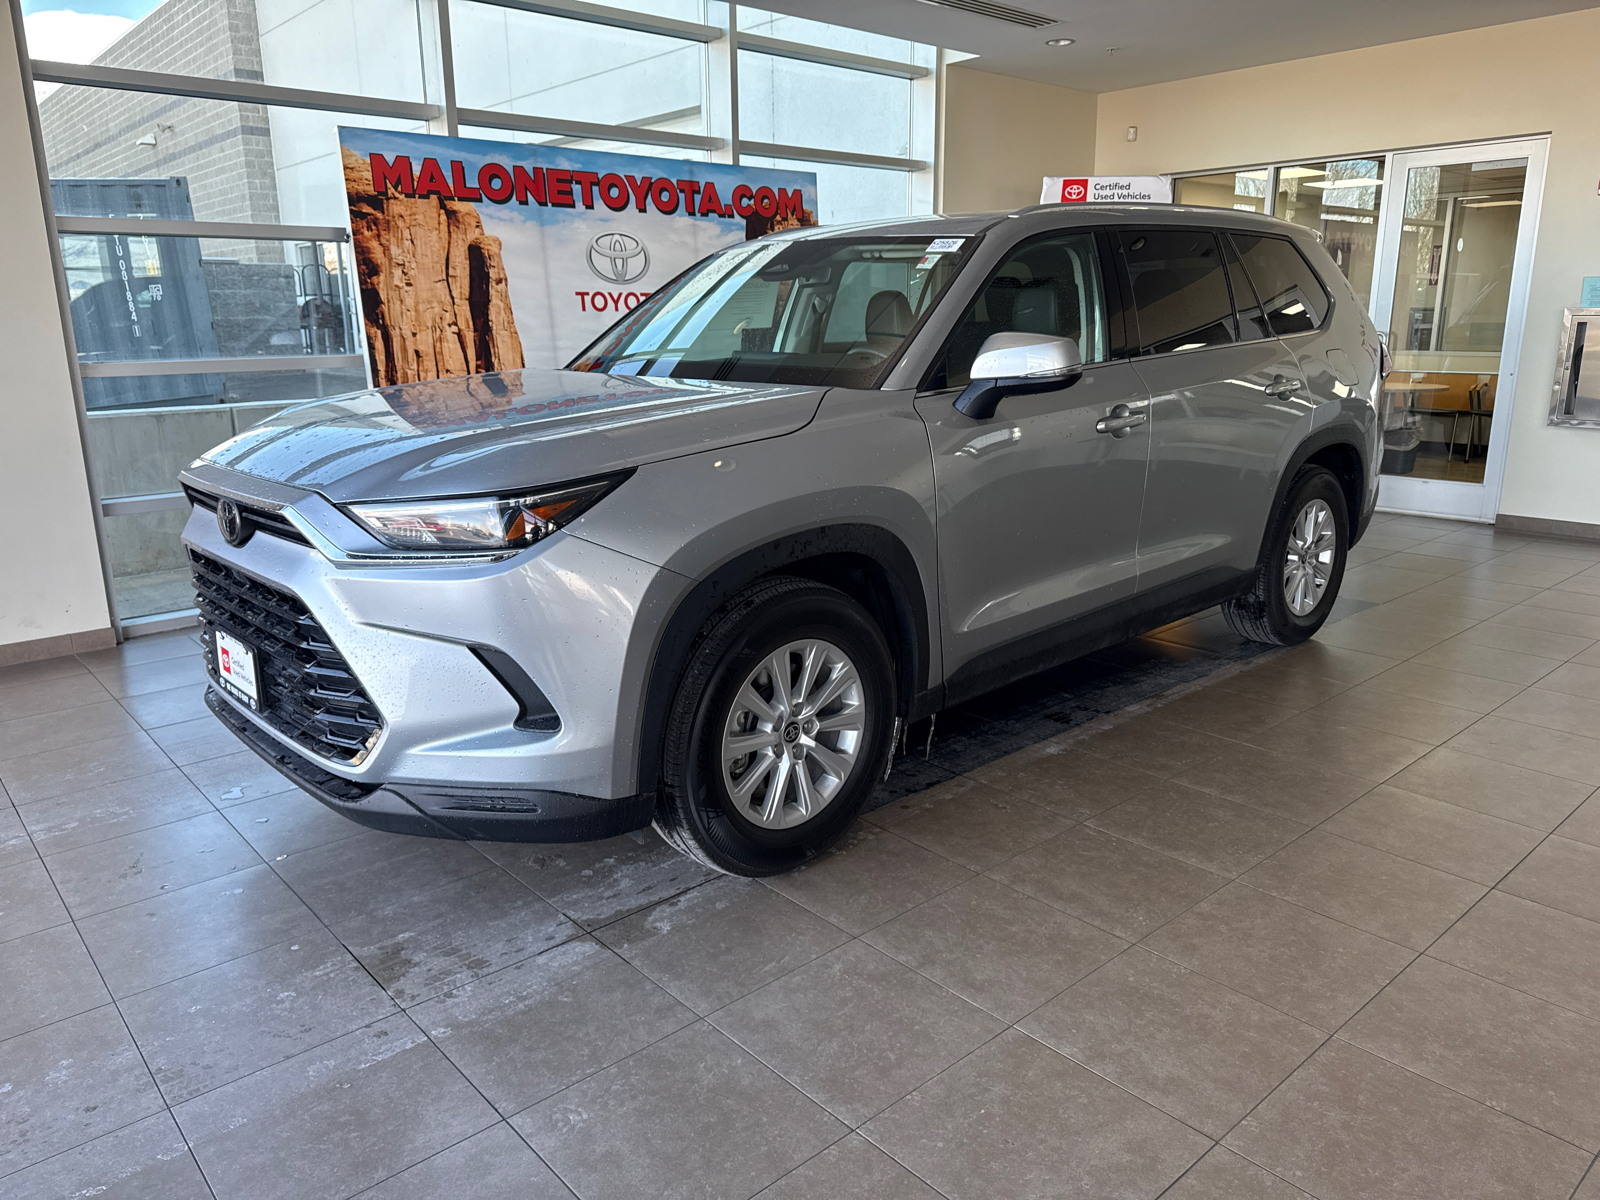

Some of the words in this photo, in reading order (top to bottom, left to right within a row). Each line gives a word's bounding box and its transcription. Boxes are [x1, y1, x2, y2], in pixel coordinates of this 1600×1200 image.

[369, 153, 804, 222] MALONETOYOTA.COM
[1093, 182, 1131, 191] Certified
[1093, 192, 1115, 200] Used
[1117, 192, 1151, 200] Vehicles
[575, 291, 652, 312] TOYO
